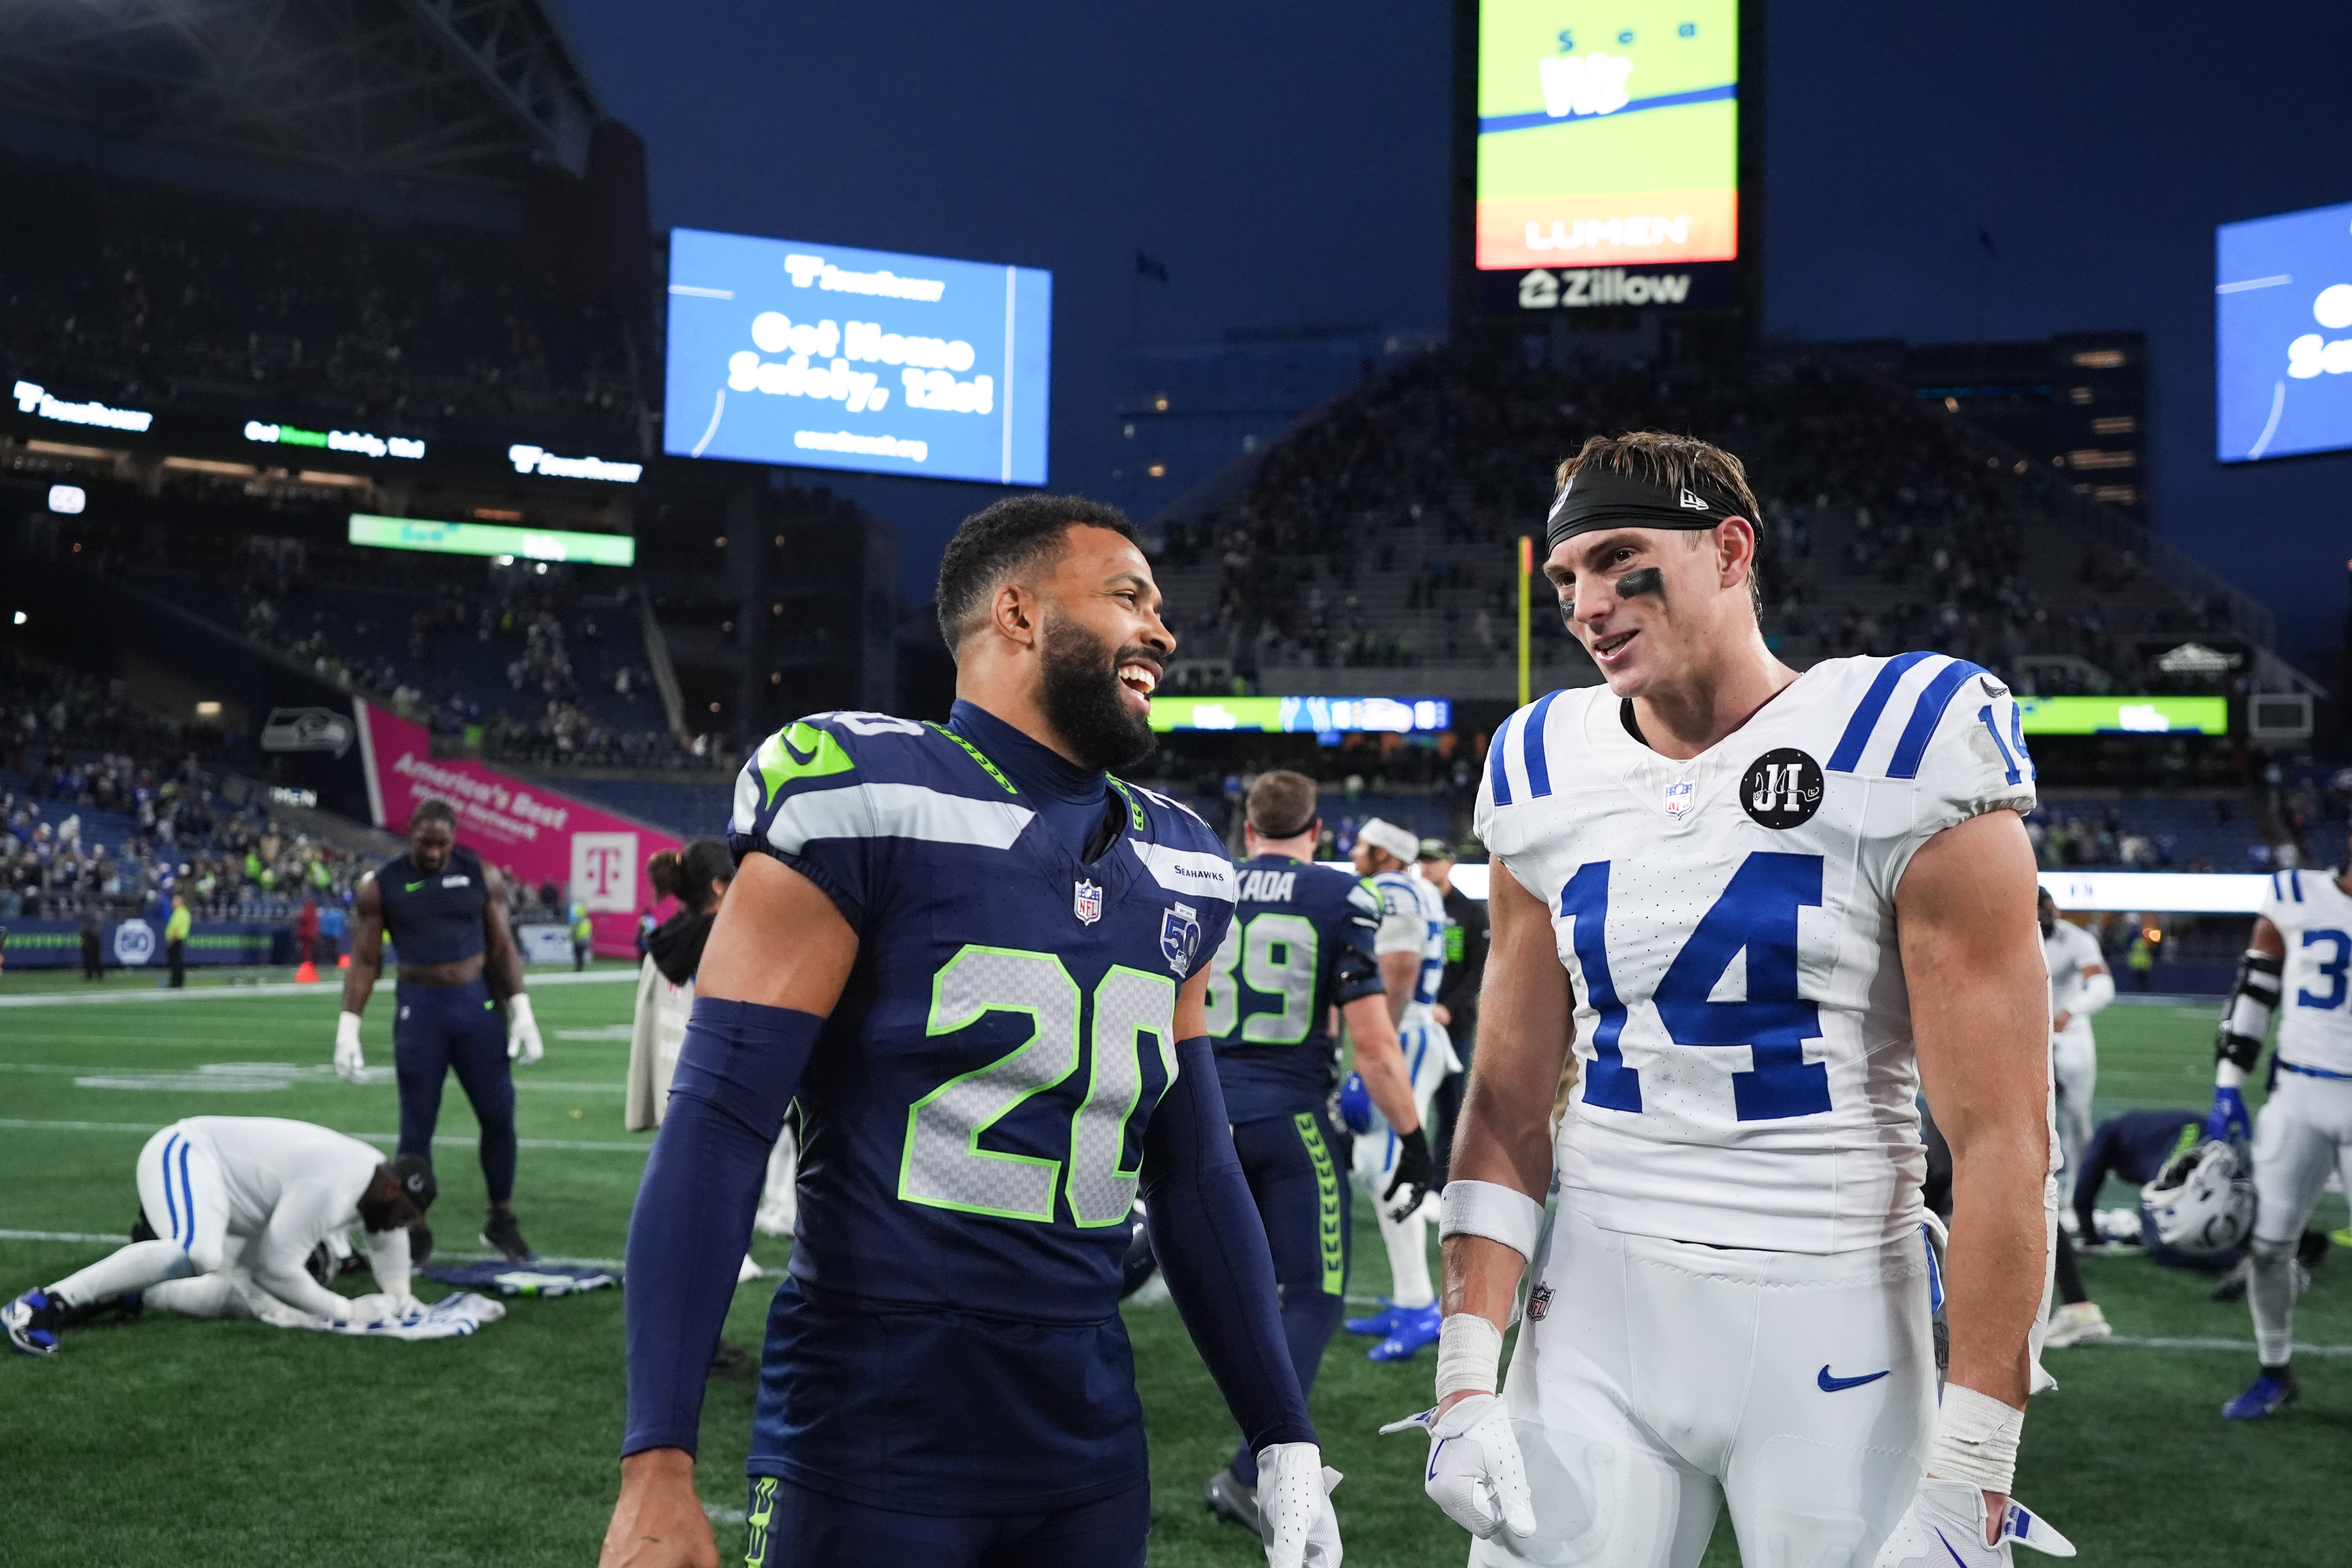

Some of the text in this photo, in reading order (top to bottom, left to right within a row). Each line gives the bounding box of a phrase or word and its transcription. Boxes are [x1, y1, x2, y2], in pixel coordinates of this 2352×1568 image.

[1526, 215, 1693, 250] LUMEN
[1561, 267, 1691, 307] Zillow
[512, 792, 567, 831] Best
[1668, 795, 1688, 811] NFL
[586, 848, 620, 895] T
[1080, 899, 1096, 916] NFL
[1560, 850, 1832, 1122] 14
[897, 944, 1179, 1228] 20
[1528, 1299, 1544, 1316] NFL
